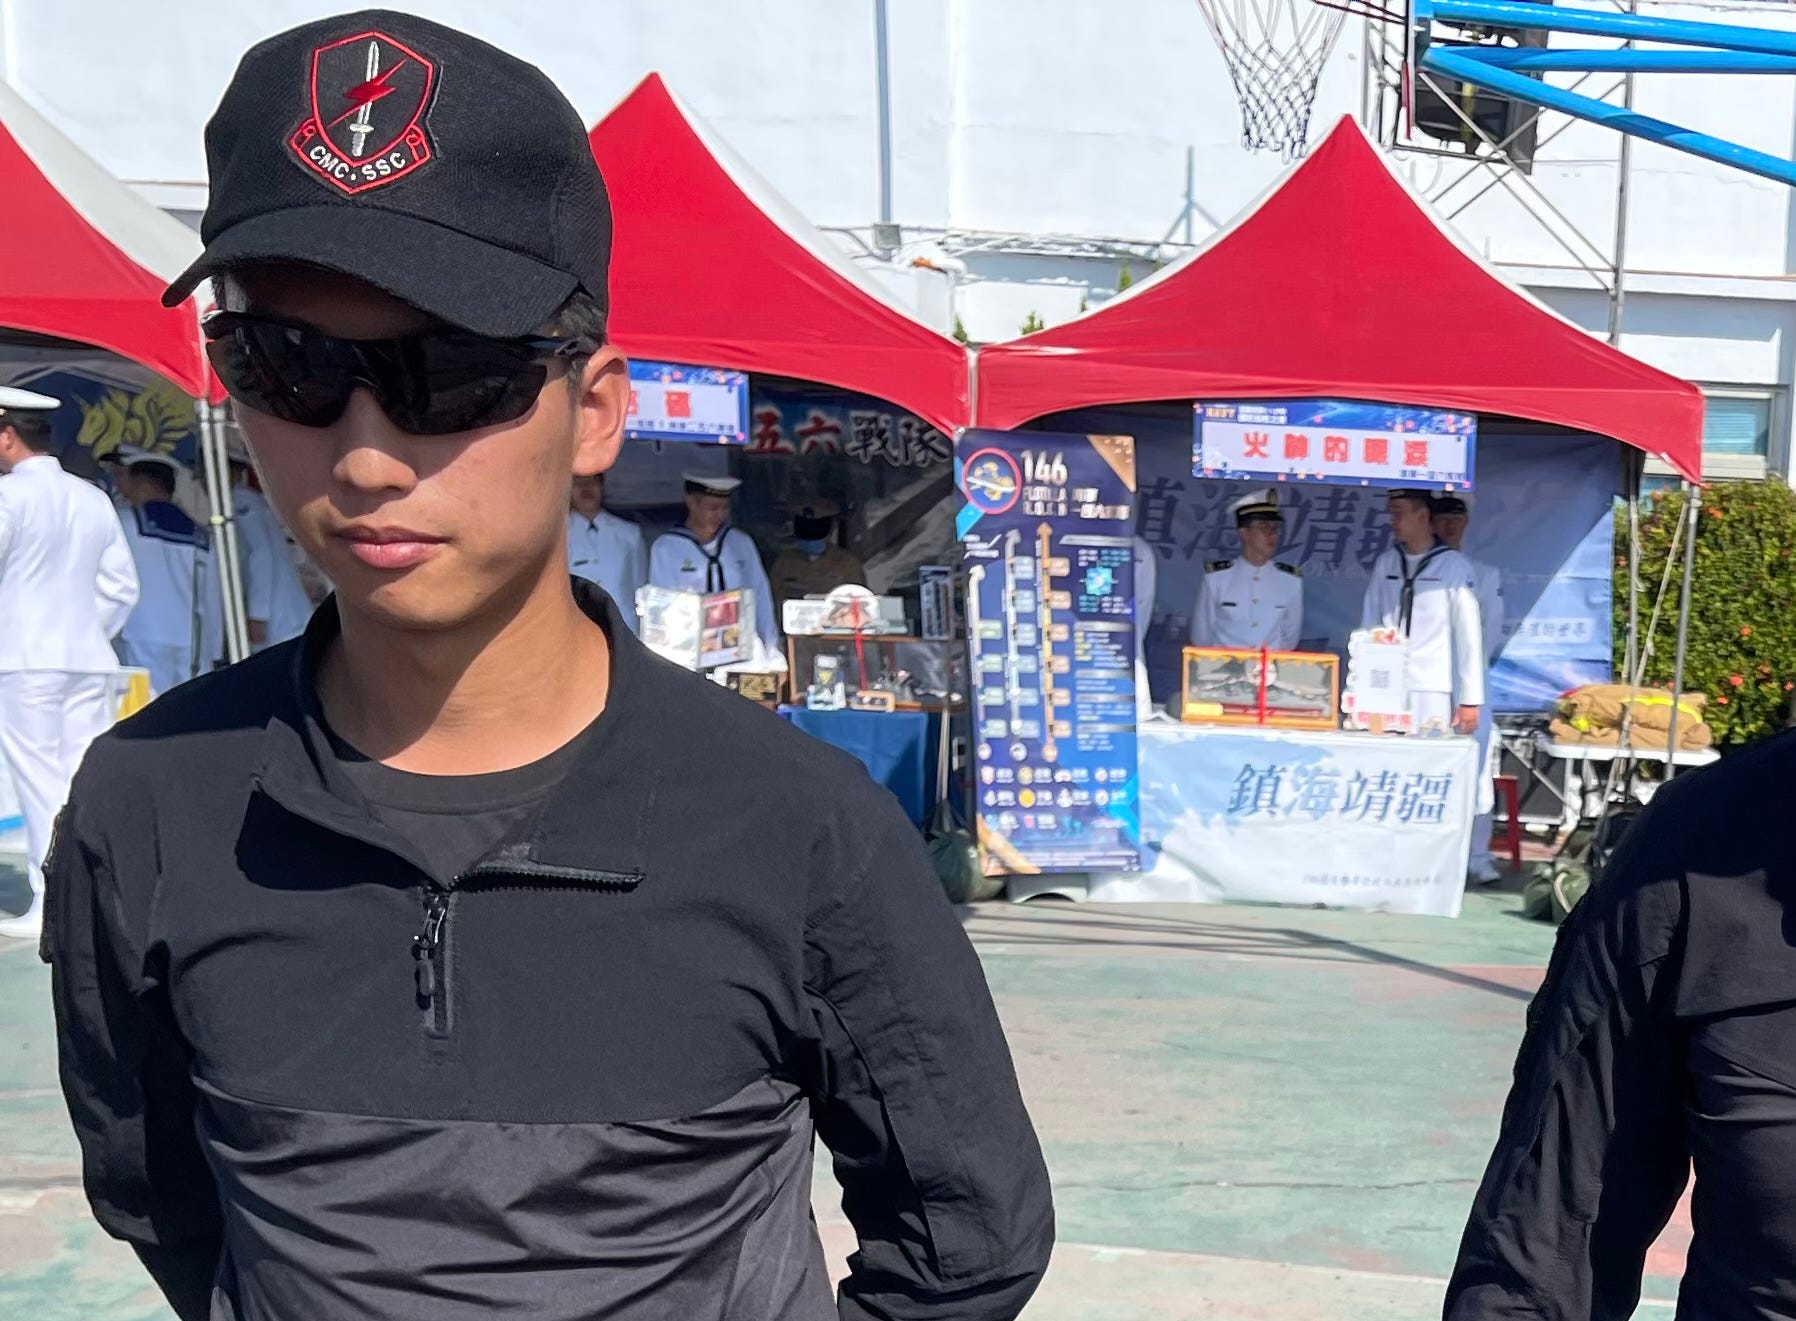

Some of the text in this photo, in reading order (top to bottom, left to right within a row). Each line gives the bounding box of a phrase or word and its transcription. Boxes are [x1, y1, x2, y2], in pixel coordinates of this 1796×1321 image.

[1021, 449, 1068, 486] 146
[1226, 762, 1455, 825] 鎮海靖疆
